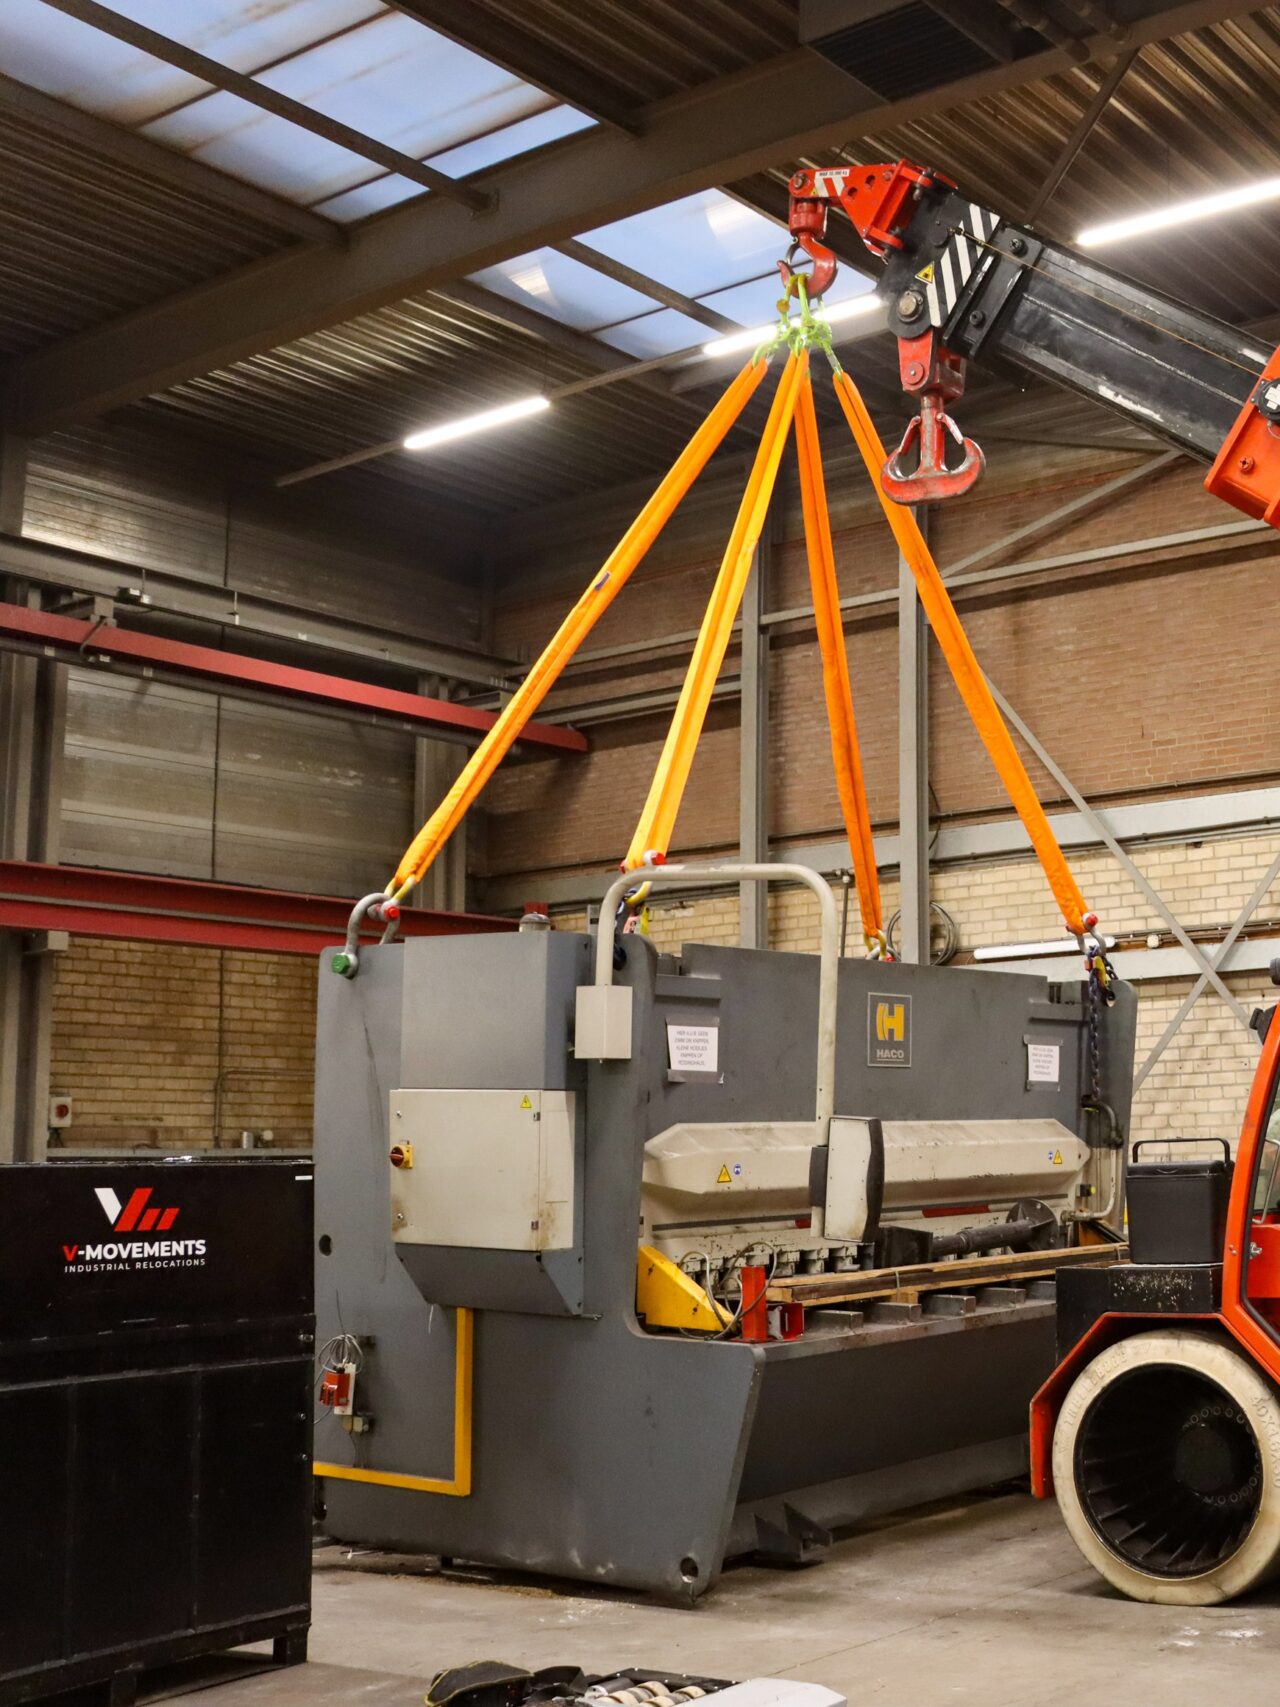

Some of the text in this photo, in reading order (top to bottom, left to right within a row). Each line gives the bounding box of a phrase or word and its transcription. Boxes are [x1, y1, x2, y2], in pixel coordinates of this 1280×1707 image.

[876, 1048, 905, 1059] HACO
[63, 1240, 206, 1262] V-MOVEMENTS
[64, 1258, 206, 1273] INDUSTRIAL RELOCATIONS
